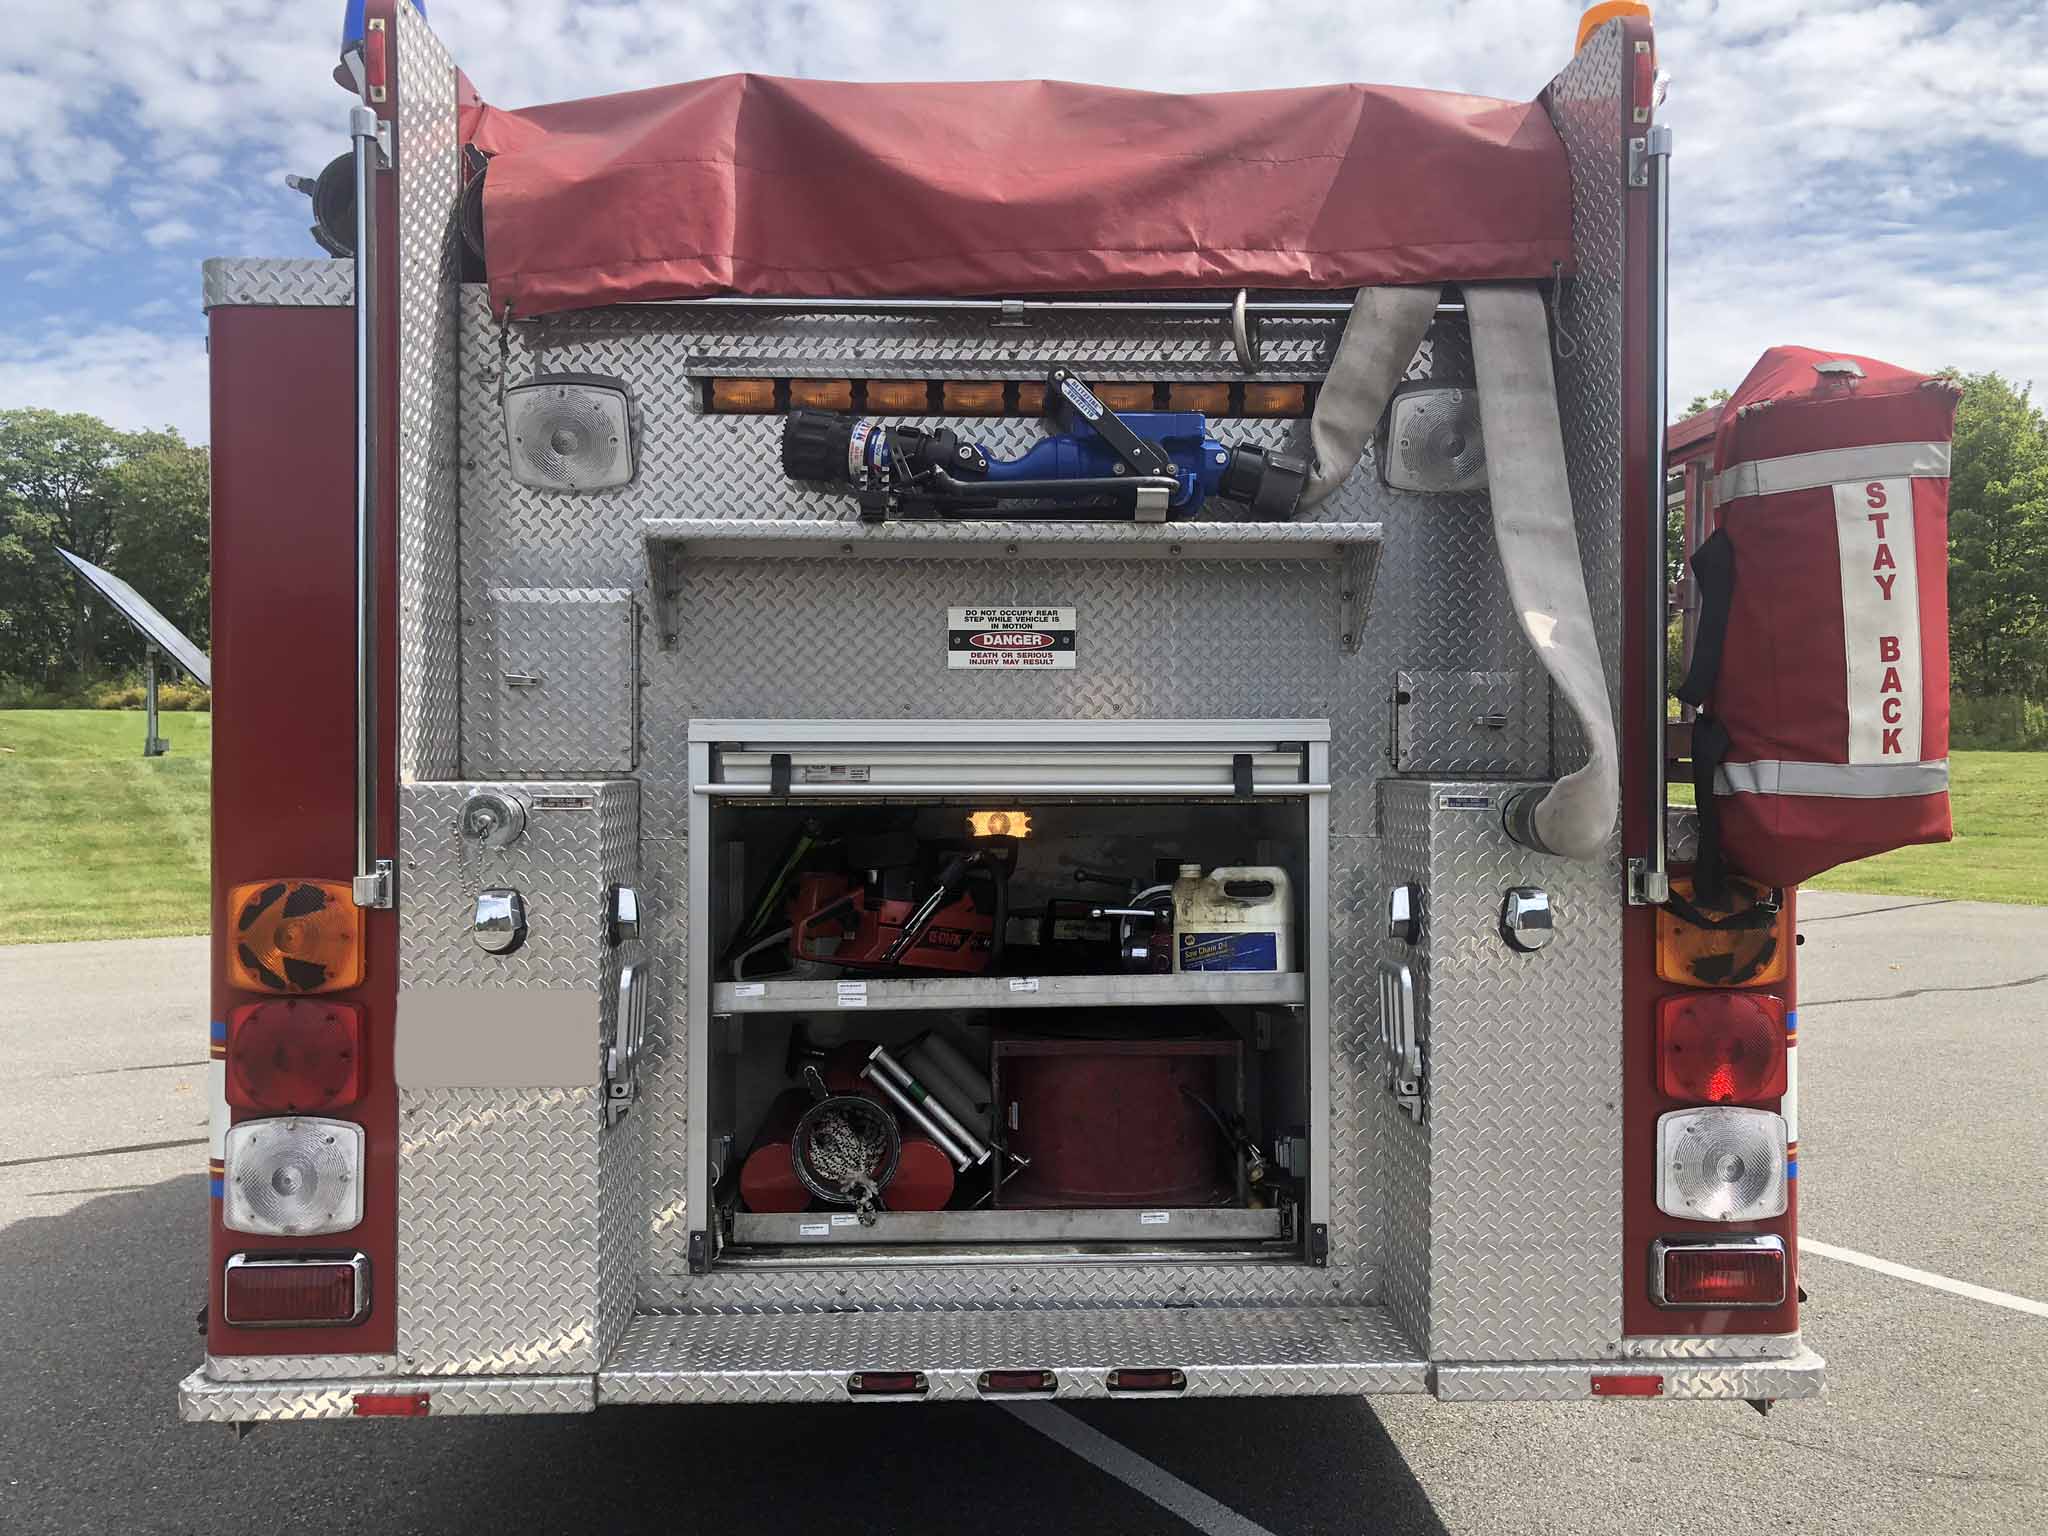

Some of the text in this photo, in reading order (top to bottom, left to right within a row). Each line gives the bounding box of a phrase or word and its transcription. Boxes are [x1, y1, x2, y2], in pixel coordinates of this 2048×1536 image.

[983, 634, 1042, 645] DANGER
[1865, 481, 1903, 755] STAY BACK
